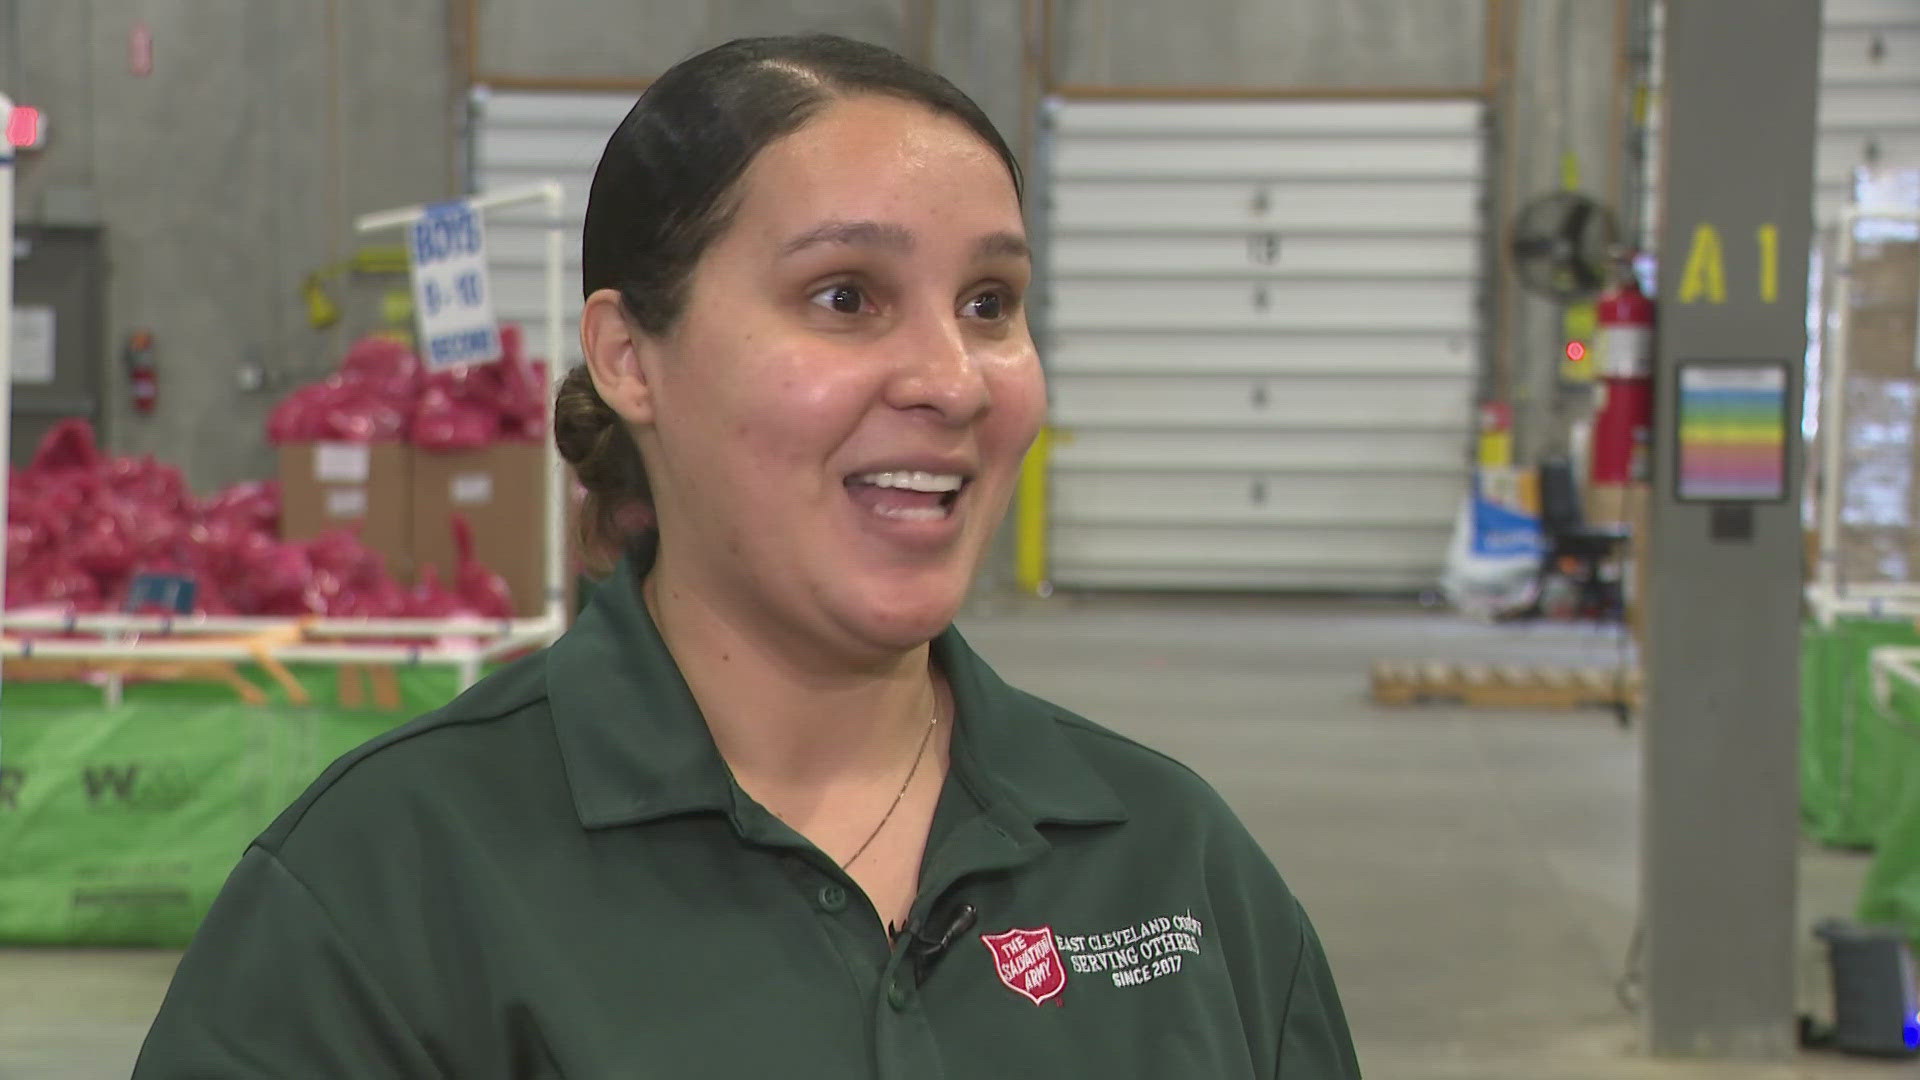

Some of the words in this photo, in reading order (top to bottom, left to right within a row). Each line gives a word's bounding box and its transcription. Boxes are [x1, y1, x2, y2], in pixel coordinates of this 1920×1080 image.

[1678, 222, 1728, 304] A
[1758, 223, 1779, 304] 1
[1001, 935, 1027, 958] THE
[1055, 935, 1085, 952] EAST
[1088, 917, 1171, 950] CLEVELAND
[1002, 935, 1050, 982] SALVATION
[1071, 946, 1139, 973] SERVING
[1140, 933, 1200, 955] OTHERS
[1025, 957, 1051, 992] ARMY
[1112, 965, 1151, 988] SINCE
[1152, 955, 1182, 976] 2017
